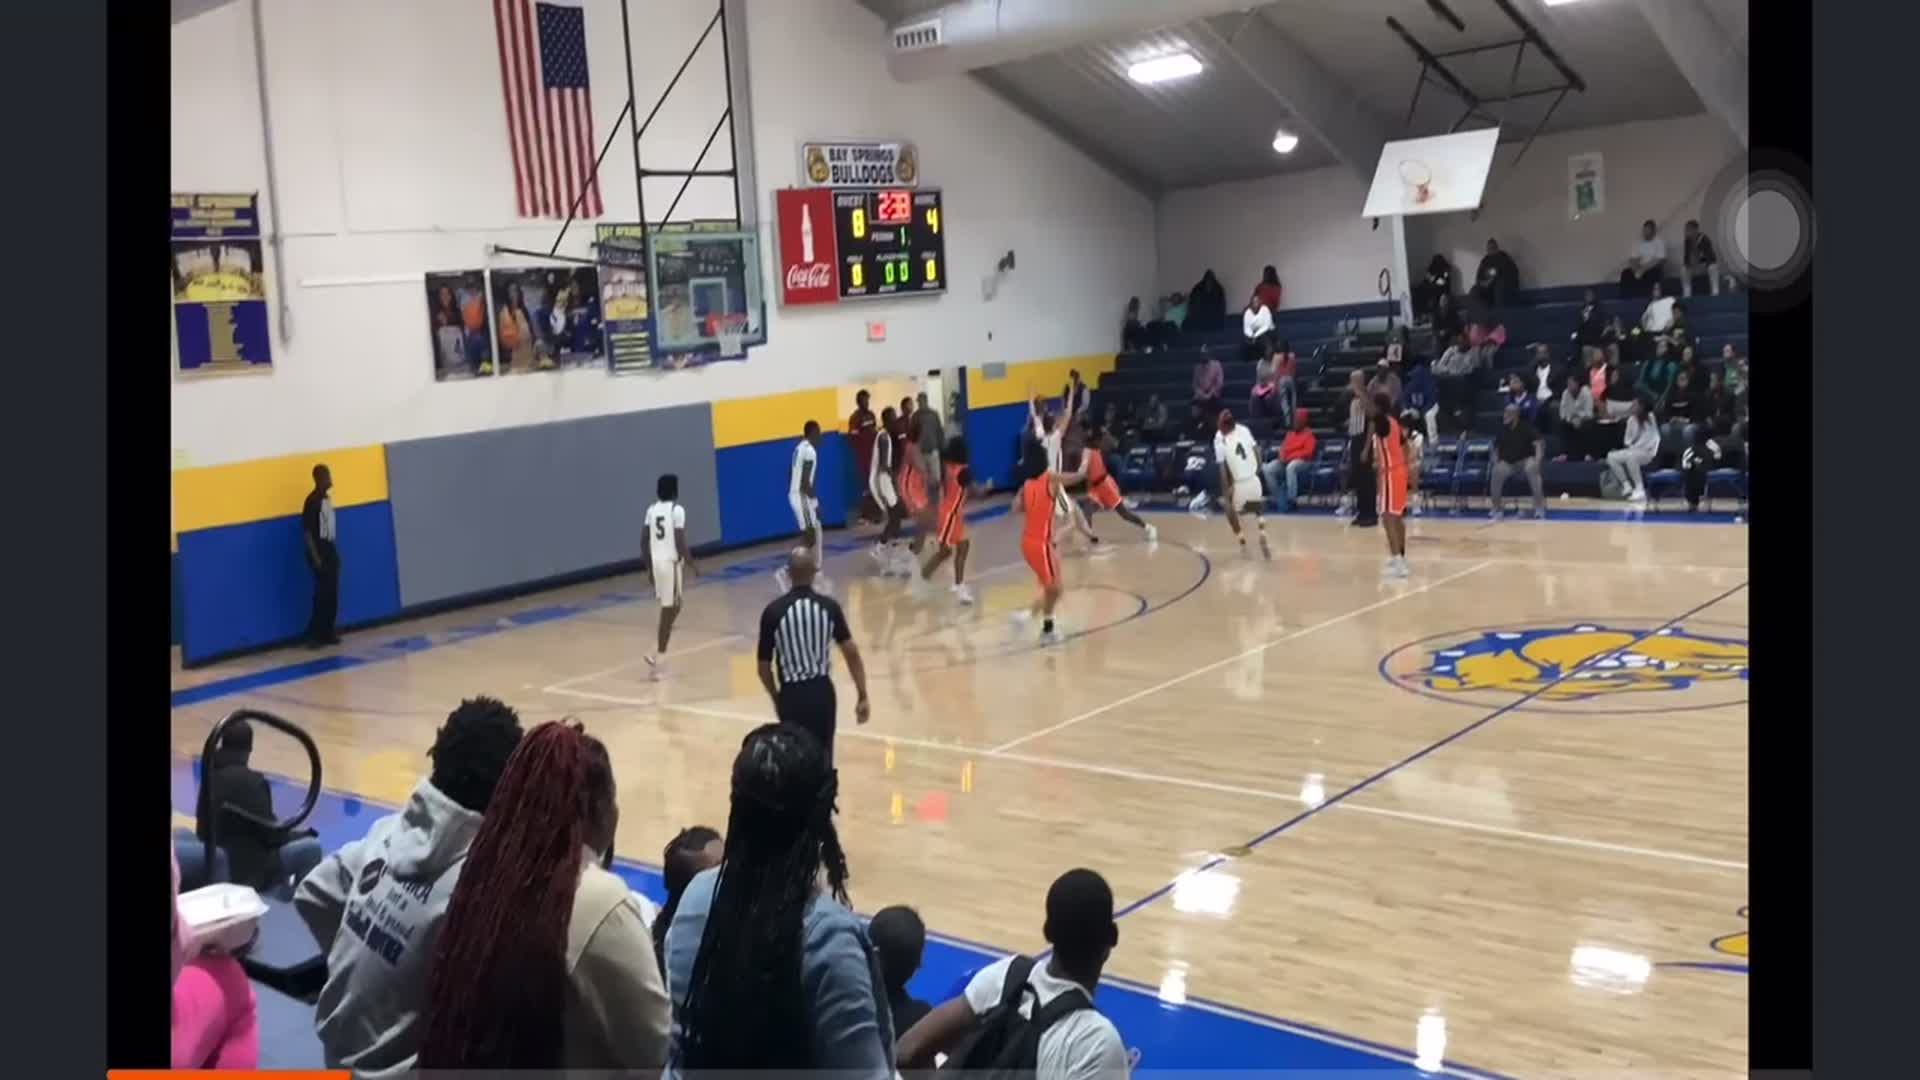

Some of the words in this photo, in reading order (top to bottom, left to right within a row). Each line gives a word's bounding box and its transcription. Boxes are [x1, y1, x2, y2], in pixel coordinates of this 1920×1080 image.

[829, 148, 848, 163] BAY
[851, 148, 895, 163] SPRINGS
[831, 164, 895, 184] BULLDOGS
[852, 208, 865, 238] 8
[926, 207, 938, 234] 4
[1235, 442, 1247, 460] 4
[655, 516, 665, 540] 5
